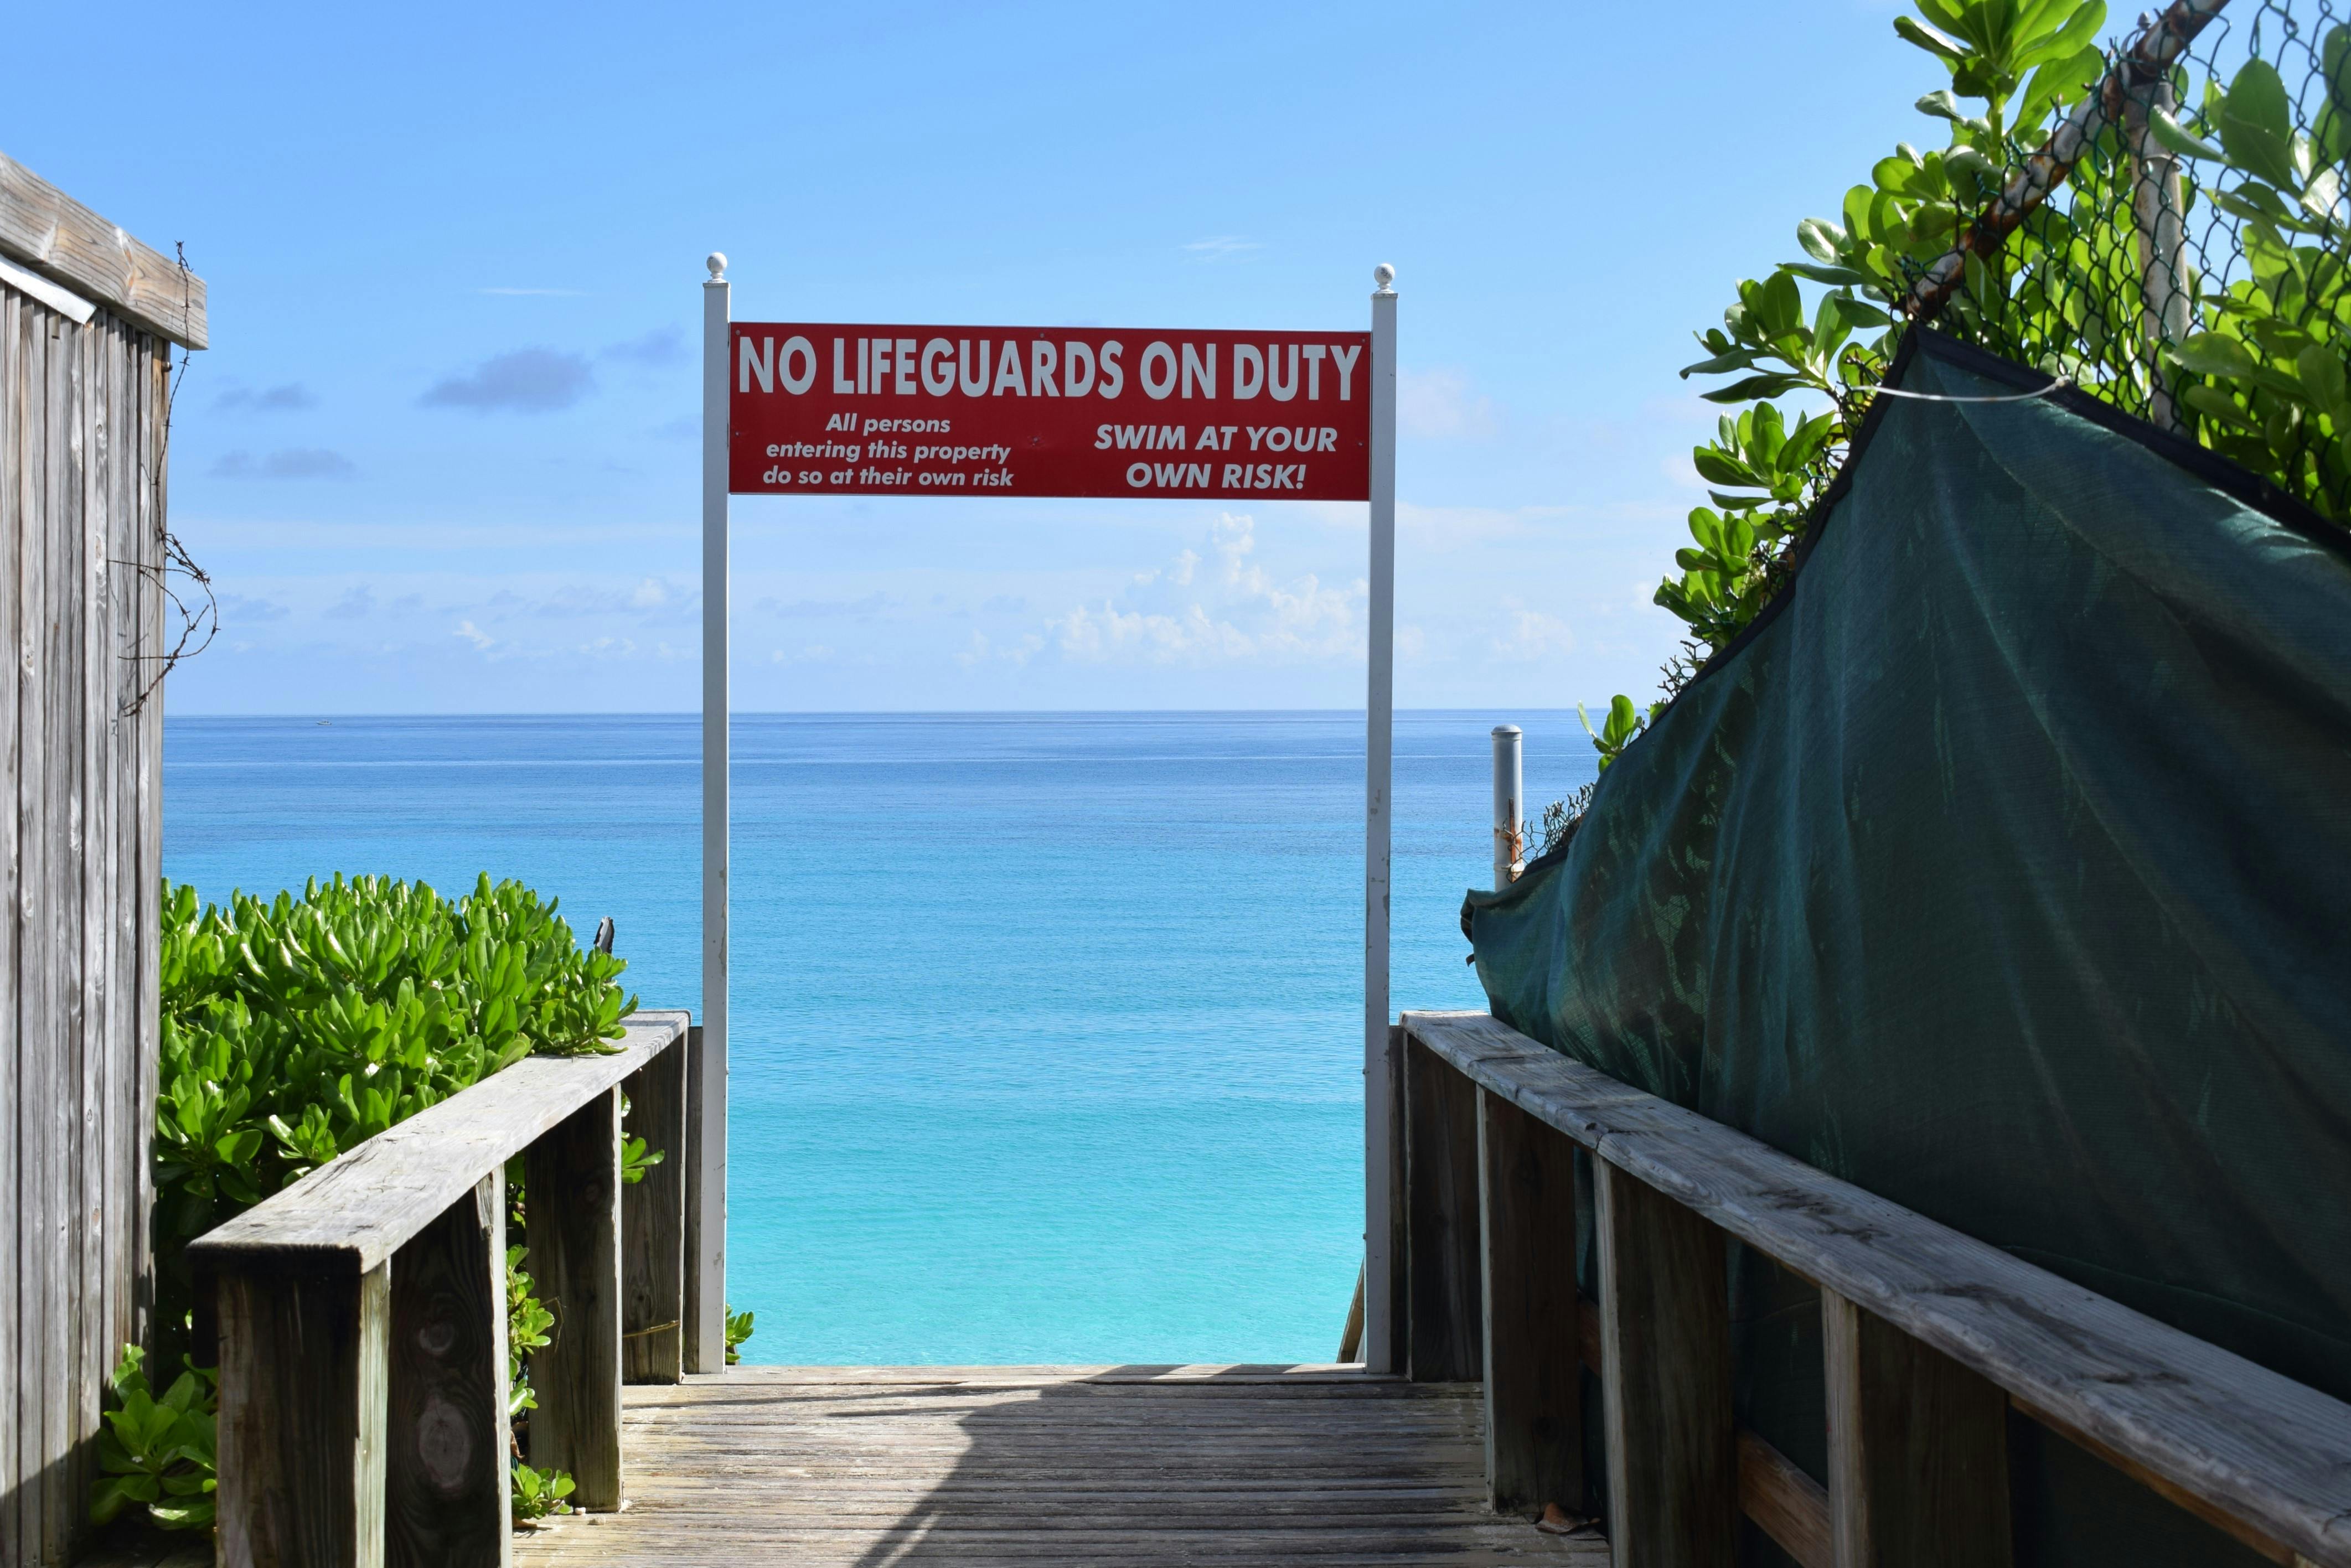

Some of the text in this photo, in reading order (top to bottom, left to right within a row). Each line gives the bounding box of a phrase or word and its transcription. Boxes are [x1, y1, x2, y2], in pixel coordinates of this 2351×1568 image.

[740, 337, 1362, 401] NO LIFEGUARDS ON DUTY
[825, 413, 950, 436] All persons
[1094, 424, 1337, 452] SWIM AT YOUR
[766, 440, 1011, 464] entering this property
[763, 465, 1014, 487] do so at their own risk
[1127, 462, 1306, 489] OWN RISK!
